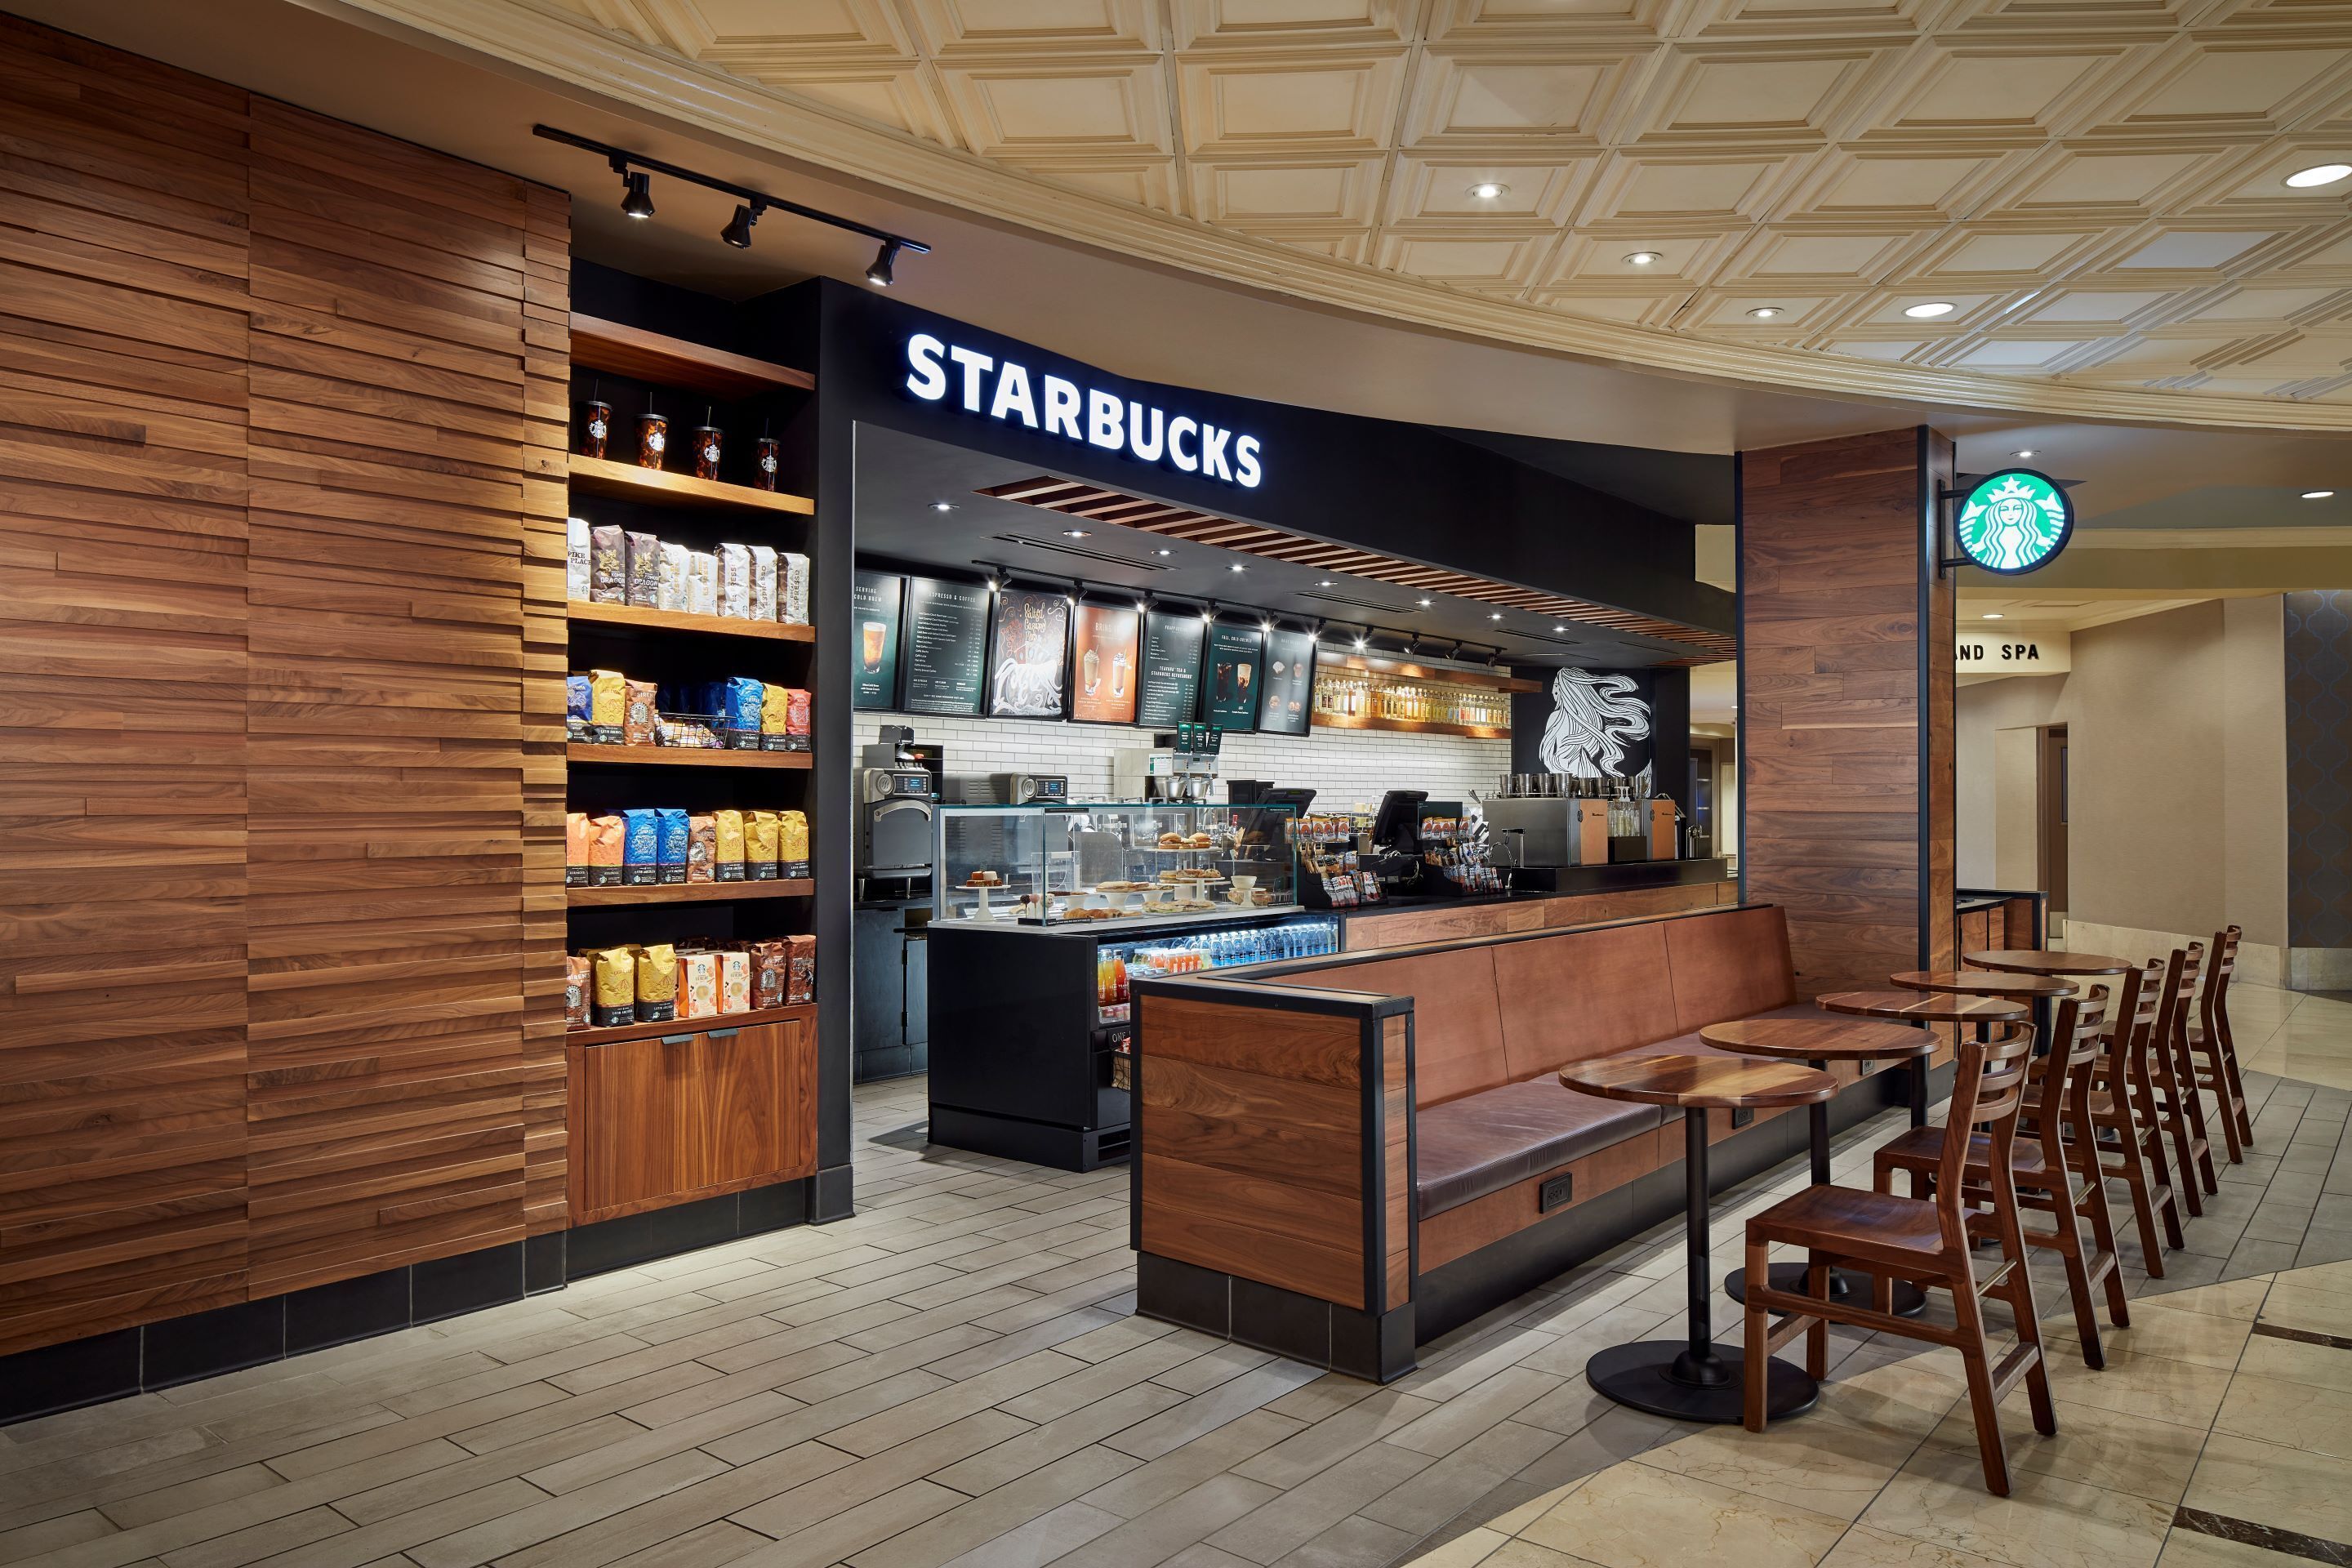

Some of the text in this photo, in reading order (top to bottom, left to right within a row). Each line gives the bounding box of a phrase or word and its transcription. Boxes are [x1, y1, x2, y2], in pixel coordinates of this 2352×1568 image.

[906, 333, 1262, 488] STARBUCKS
[568, 550, 586, 559] PIKE
[1954, 644, 2039, 660] ND SPA
